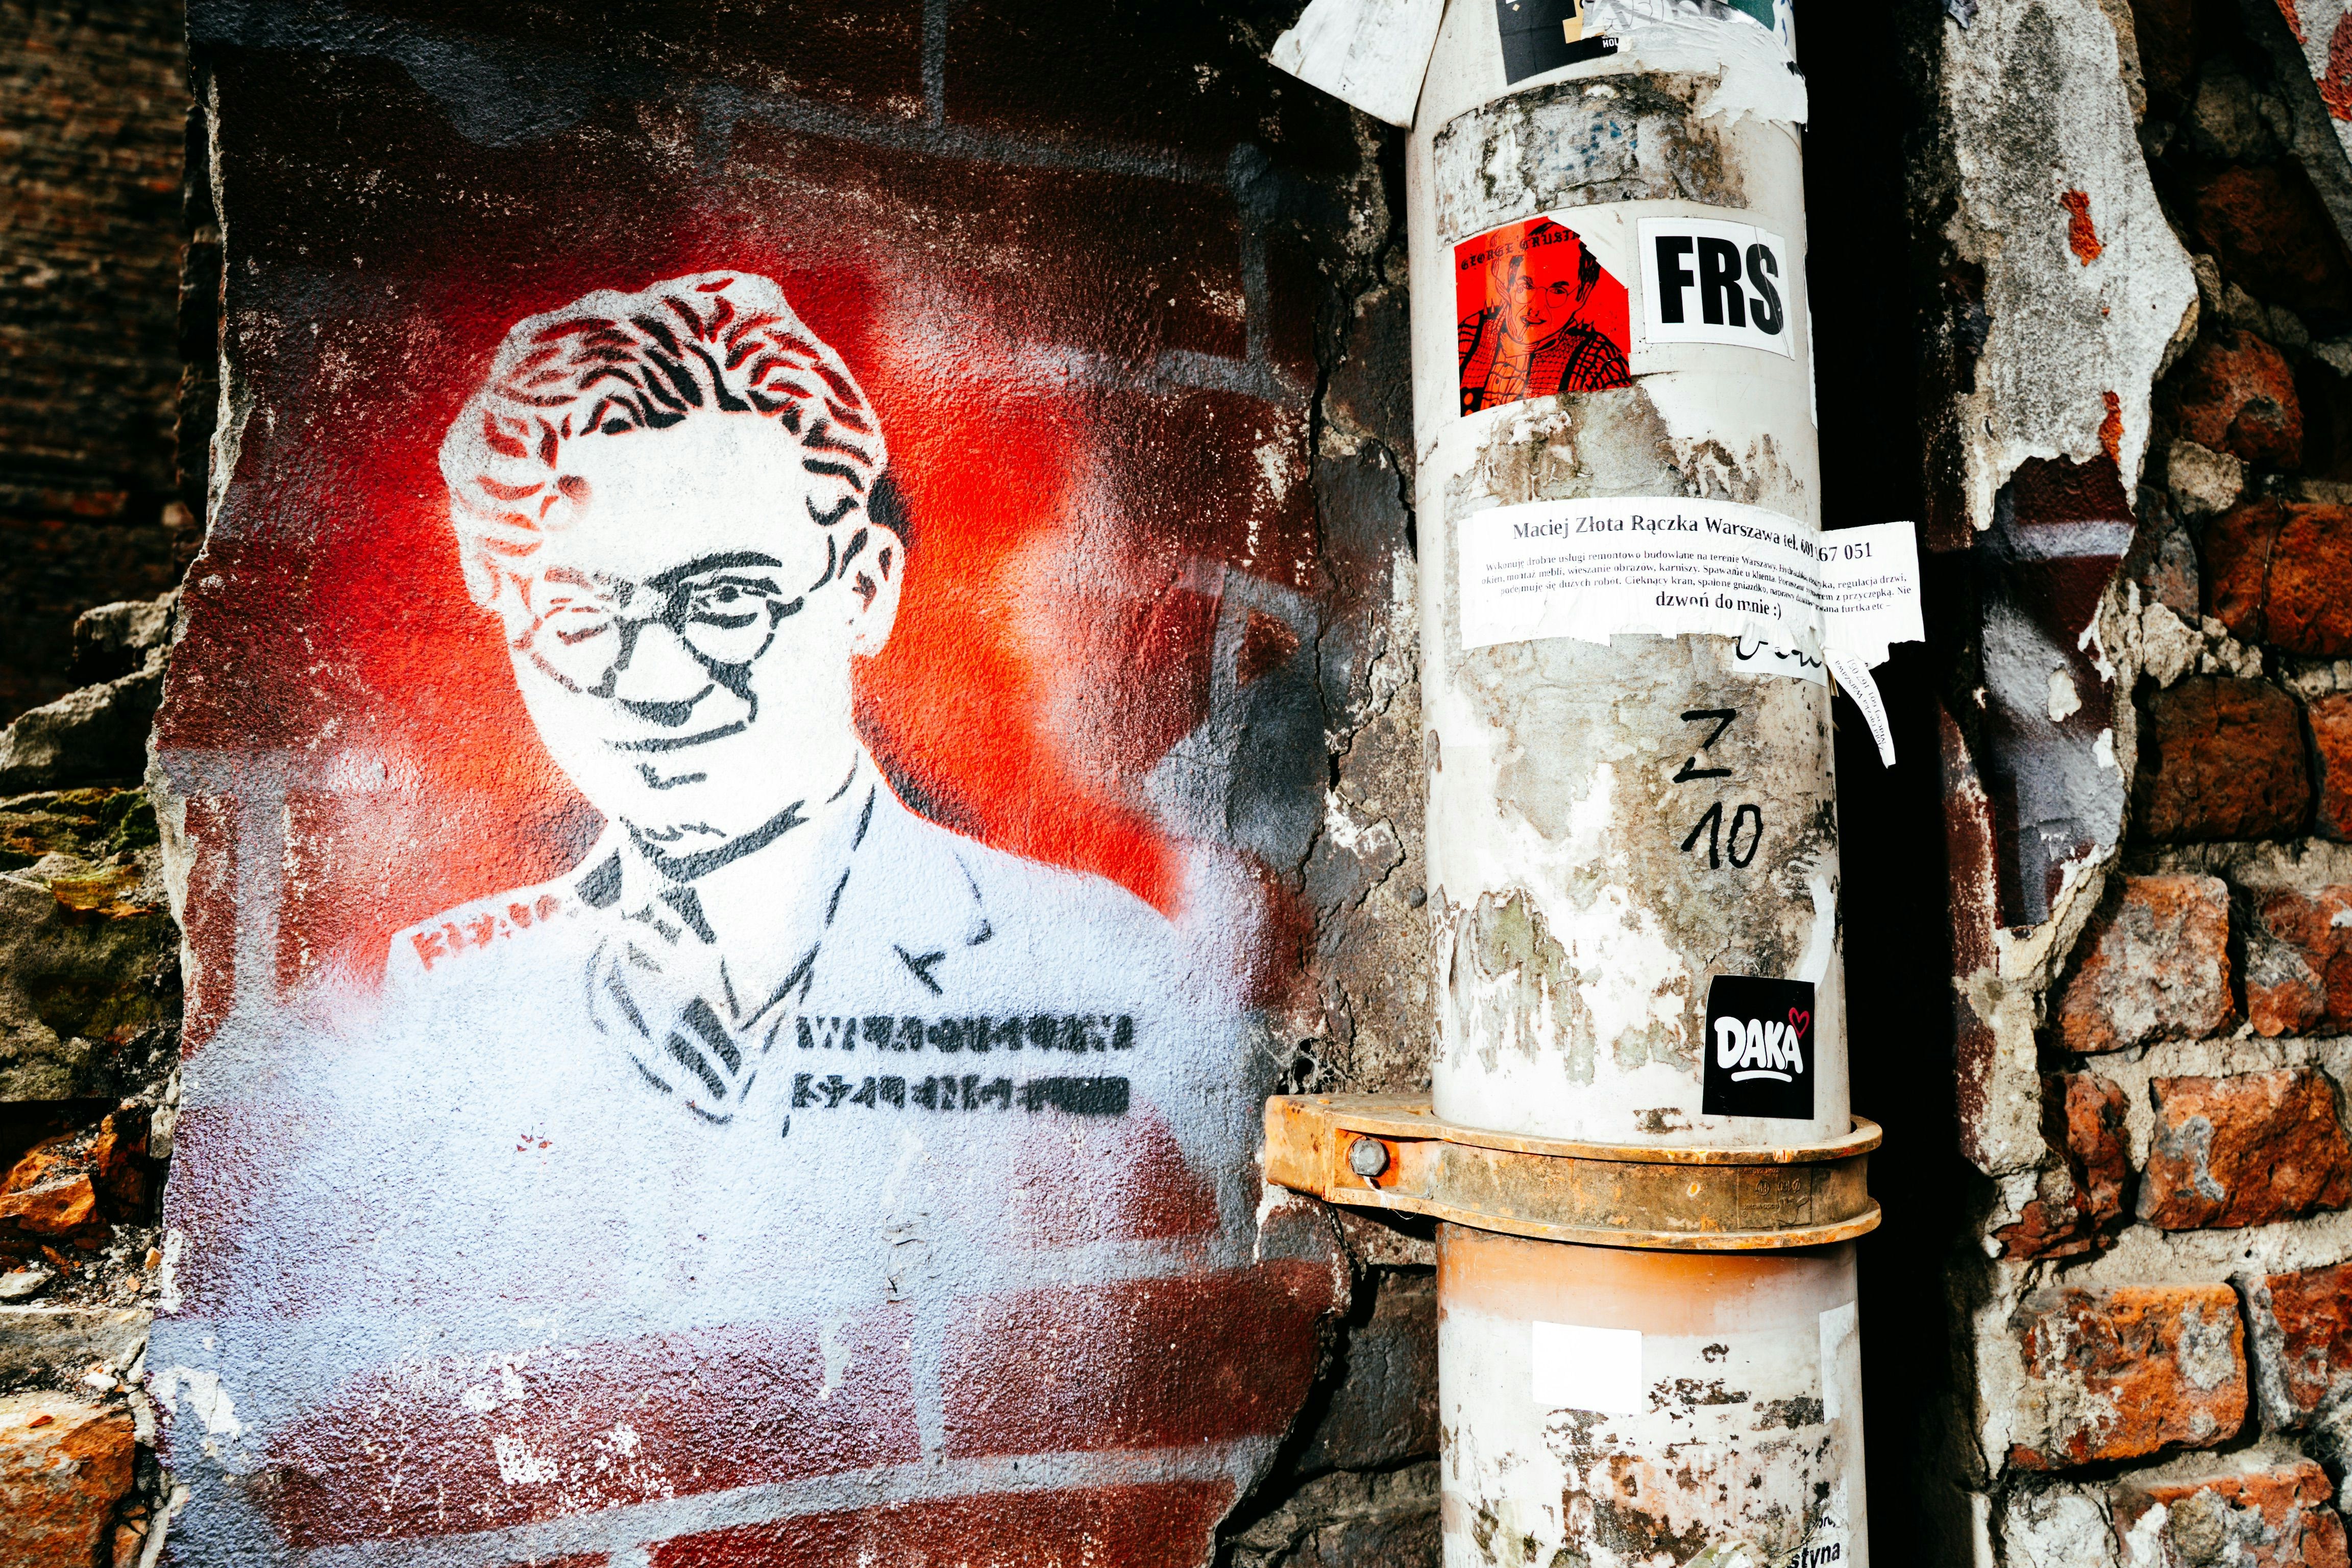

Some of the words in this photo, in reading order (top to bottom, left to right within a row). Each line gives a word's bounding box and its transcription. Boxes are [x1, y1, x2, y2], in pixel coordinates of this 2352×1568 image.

[1461, 242, 1514, 270] GEORGE
[1655, 235, 1784, 335] FRS
[1513, 517, 1569, 539] Maciej
[1575, 516, 1624, 533] Złota
[1630, 514, 1699, 536] Rączka
[1705, 517, 1780, 545] Warszawa
[1784, 534, 1798, 551] tel.
[1844, 542, 1873, 560] 051
[1482, 575, 1505, 584] okien,
[1507, 570, 1536, 581] montaż
[1539, 568, 1565, 577] mebli,
[1567, 564, 1611, 574] wieszanie
[1614, 562, 1656, 572] obrazów,
[1659, 563, 1700, 574] karniszy.
[1703, 565, 1743, 577] Spawanie
[1752, 570, 1776, 582] klienta.
[1843, 589, 1894, 602] przyczepką.
[1897, 586, 1911, 595] Nie
[1558, 553, 1585, 564] usługi
[1644, 550, 1694, 559] budowlane
[1710, 553, 1739, 563] terenie
[1838, 578, 1877, 590] regulacja
[1880, 573, 1906, 584] drzwi,
[1559, 578, 1590, 589] dużych
[1594, 577, 1622, 585] robót.
[1625, 576, 1668, 586] Cieknący
[1671, 576, 1695, 586] kran,
[1698, 578, 1730, 588] spalone
[1733, 581, 1768, 594] gniazdko,
[1770, 588, 1794, 602] naprawy
[1842, 604, 1870, 612] furtka
[1656, 591, 1709, 607] dzwoń
[1715, 594, 1733, 609] do
[1737, 599, 1770, 615] mnie
[1834, 660, 1863, 699] Warszawa
[1847, 658, 1859, 674] 051
[1856, 676, 1870, 689] 167
[1672, 708, 1736, 783] Z
[1681, 802, 1763, 869] 10
[1714, 1016, 1803, 1073] DAKA
